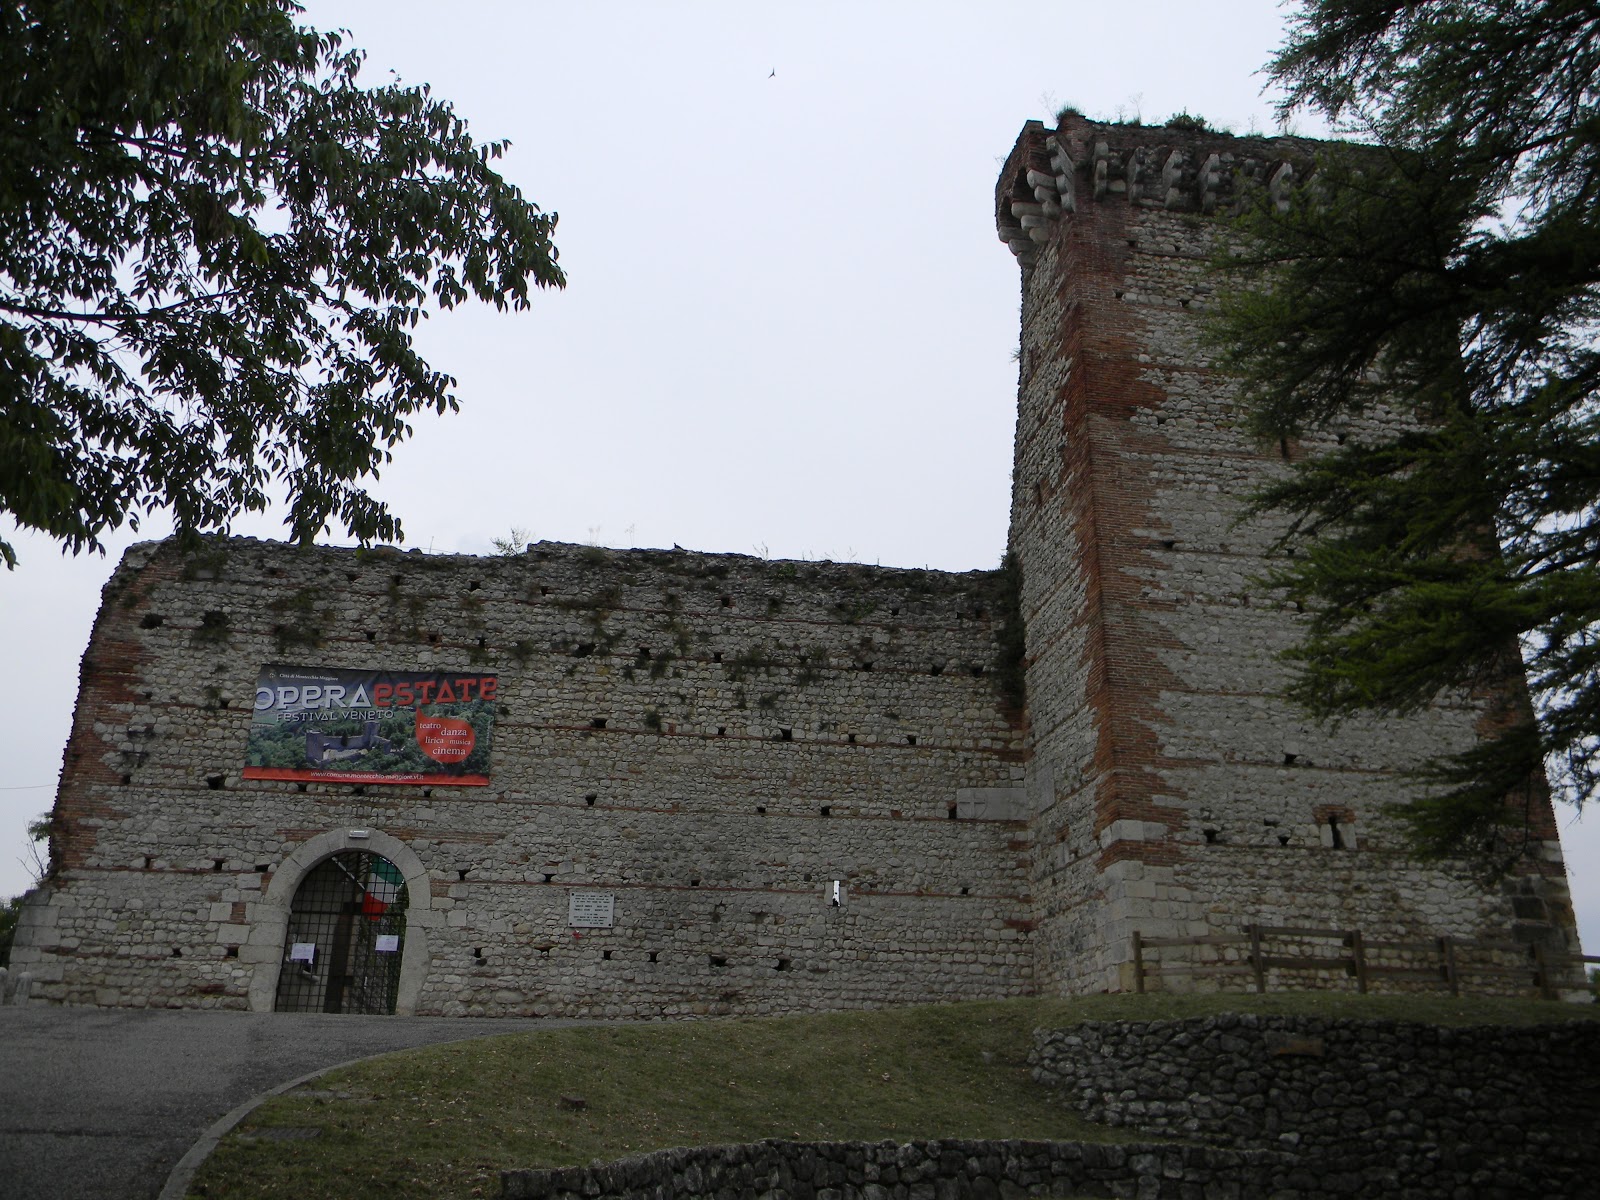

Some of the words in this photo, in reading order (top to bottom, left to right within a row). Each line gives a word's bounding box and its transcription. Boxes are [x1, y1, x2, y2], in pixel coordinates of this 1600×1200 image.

[441, 728, 467, 736] danza
[425, 736, 444, 744] lirica
[432, 747, 466, 755] cinema
